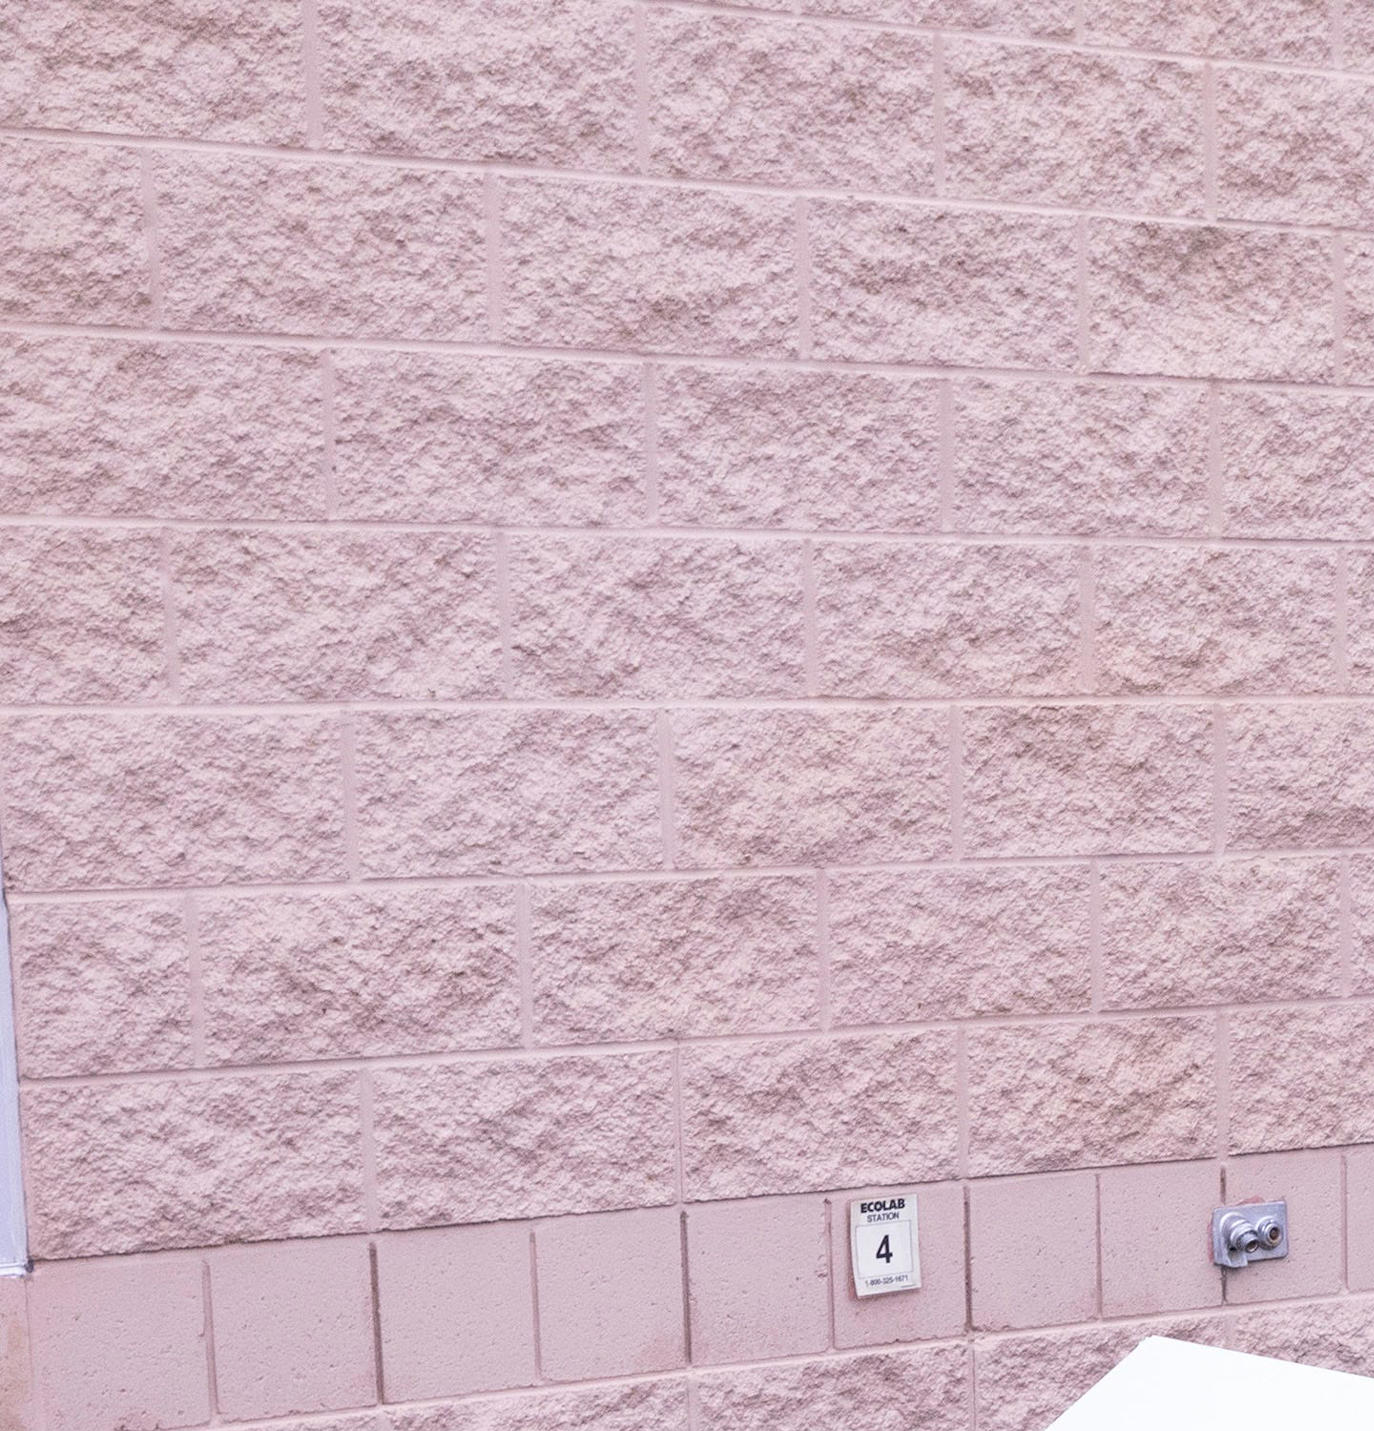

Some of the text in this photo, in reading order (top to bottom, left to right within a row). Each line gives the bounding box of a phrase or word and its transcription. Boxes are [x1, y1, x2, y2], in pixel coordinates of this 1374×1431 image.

[861, 1198, 906, 1213] ECOLAB
[867, 1212, 900, 1223] STATION
[876, 1234, 893, 1263] 4
